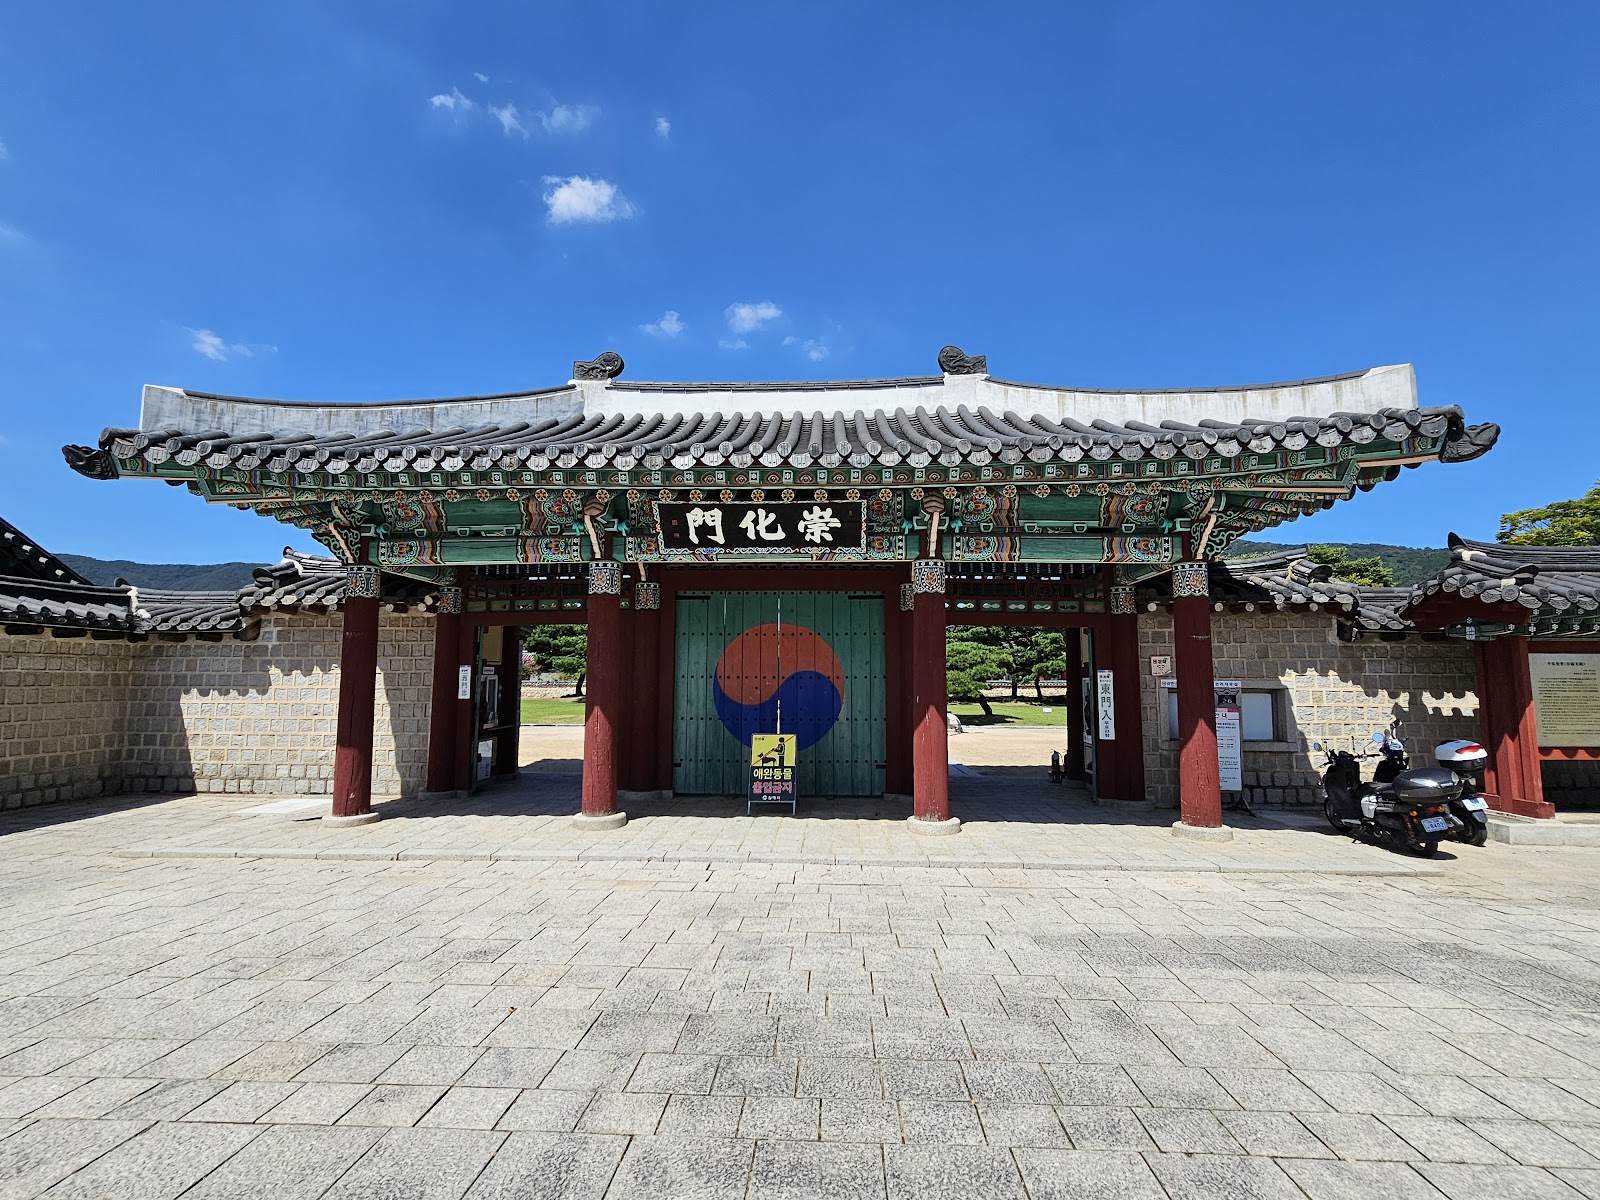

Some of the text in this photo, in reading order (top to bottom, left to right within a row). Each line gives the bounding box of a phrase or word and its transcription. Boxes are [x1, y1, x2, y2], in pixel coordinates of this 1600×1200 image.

[1100, 683, 1112, 721] 東門入
[753, 768, 793, 780] 애완동물
[752, 781, 793, 794] 출입금지
